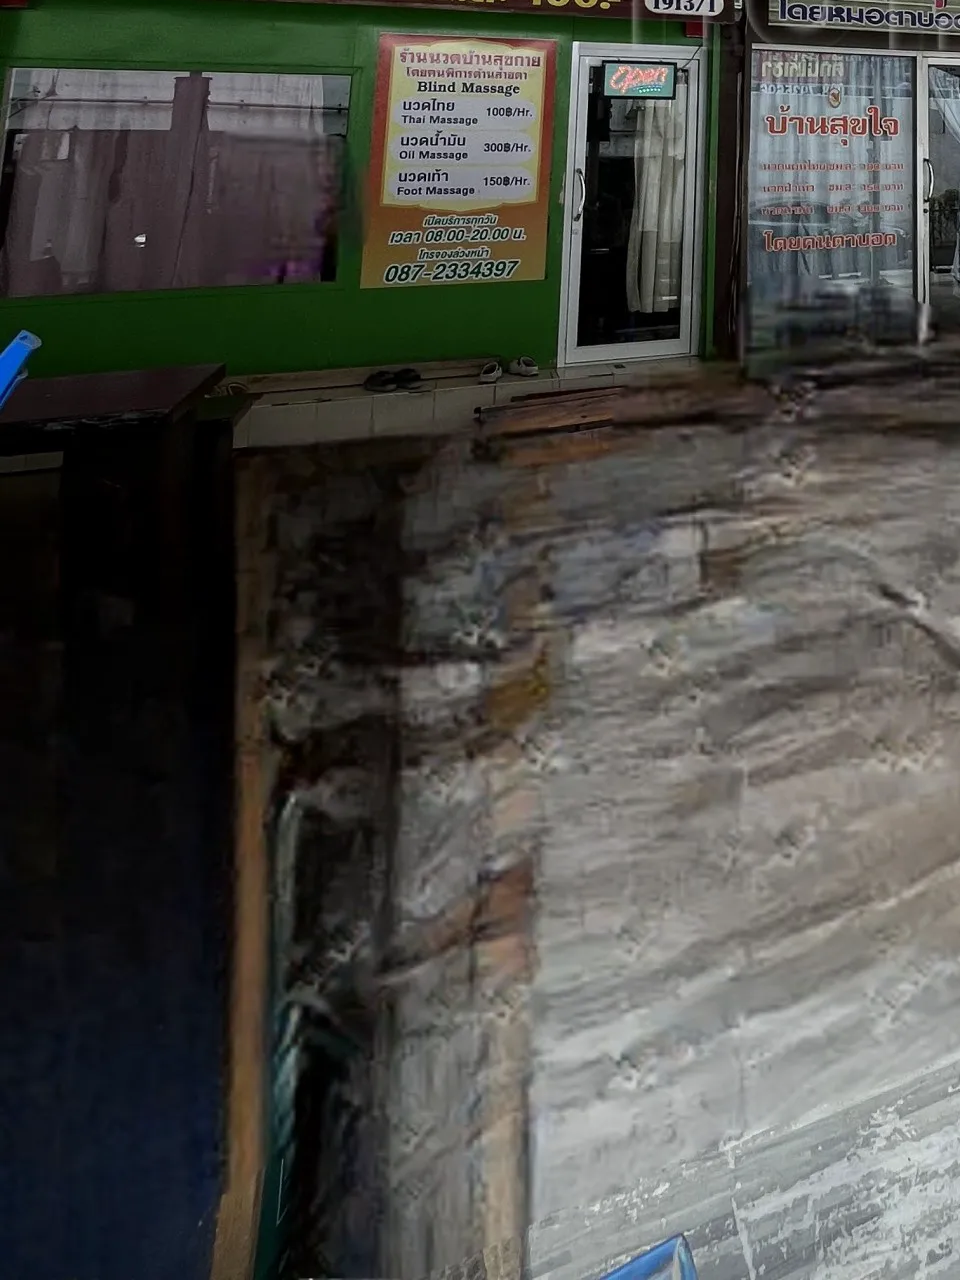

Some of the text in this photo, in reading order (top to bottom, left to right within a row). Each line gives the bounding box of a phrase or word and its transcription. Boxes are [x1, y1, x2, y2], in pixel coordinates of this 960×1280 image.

[399, 48, 541, 70] ร้านนวดบ้านสุขกาย
[418, 81, 520, 97] Blind Massage
[402, 98, 455, 111] นวดไทย
[401, 114, 478, 126] Thai Massage
[765, 104, 900, 147] บ้านสุขใจ
[400, 130, 466, 146] นวดน้ำมัน
[399, 150, 468, 161] Oil Massage
[398, 169, 449, 182] นวดเท้า
[397, 186, 475, 197] Foot Massage
[424, 214, 497, 228] เปิดบริการทุกวัน
[390, 227, 526, 244] เวลา 08.00-20.00 น.
[763, 229, 897, 252] โดยคนตาบอด
[418, 246, 490, 260] โทรจองล่วงหน้า
[384, 260, 520, 283] 087-2334397
